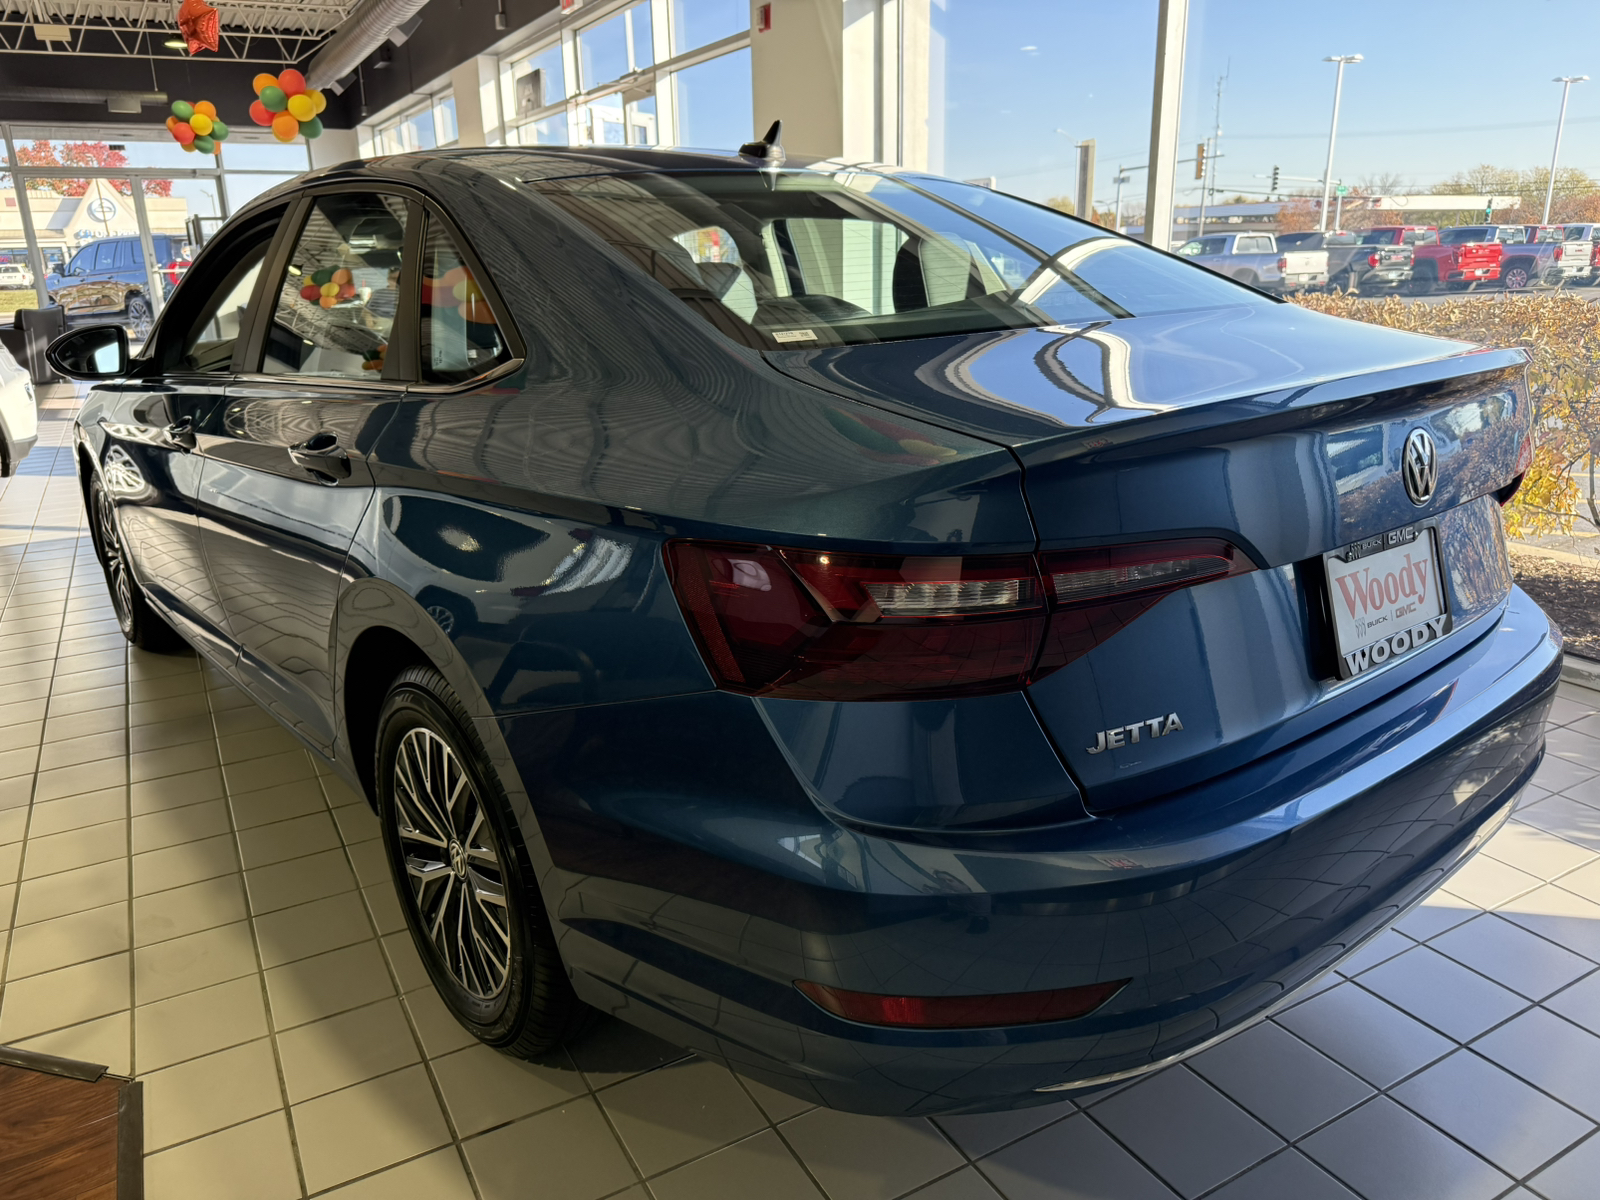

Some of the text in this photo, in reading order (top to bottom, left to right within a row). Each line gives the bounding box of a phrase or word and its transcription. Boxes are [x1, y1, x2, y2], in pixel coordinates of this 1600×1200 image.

[1388, 526, 1414, 545] GMC
[1335, 553, 1428, 620] Woody
[1367, 601, 1417, 629] BUICK GMC
[1345, 614, 1447, 676] WOODY
[1085, 712, 1184, 755] JETTA
